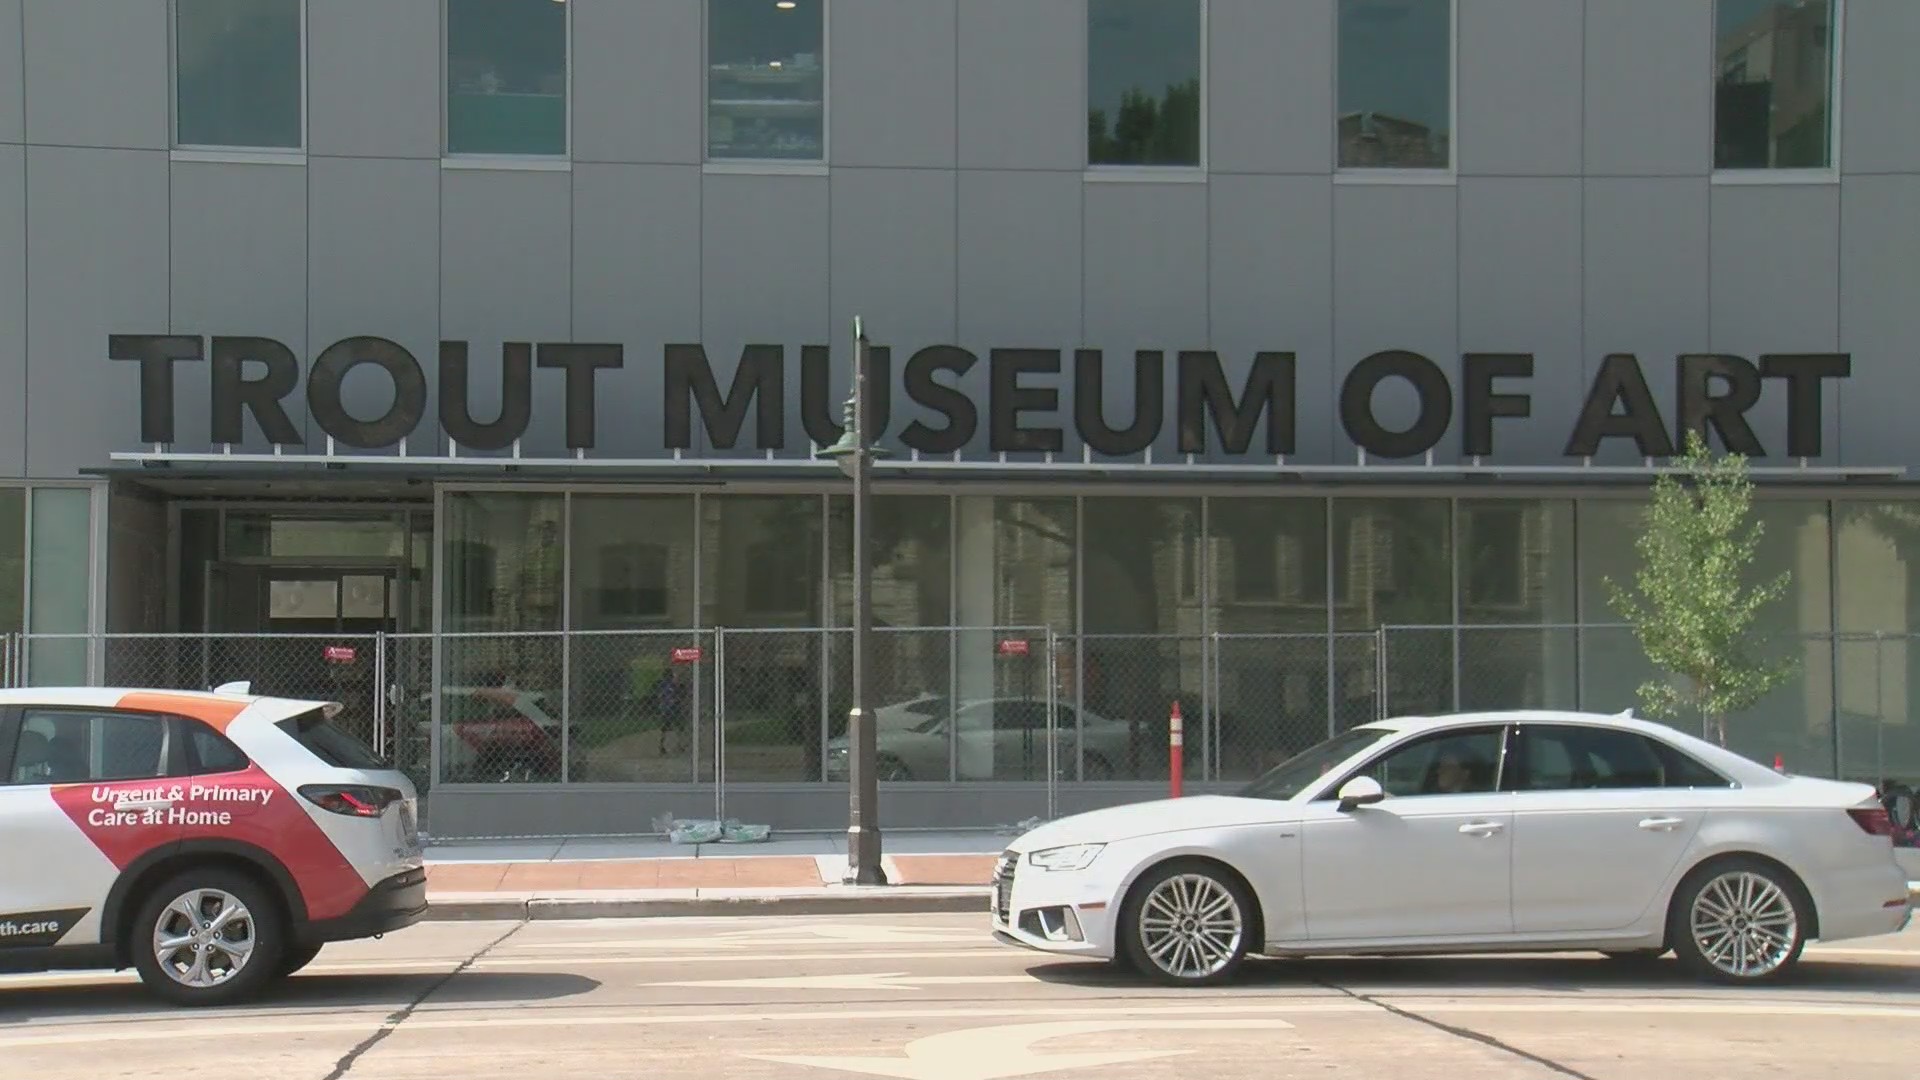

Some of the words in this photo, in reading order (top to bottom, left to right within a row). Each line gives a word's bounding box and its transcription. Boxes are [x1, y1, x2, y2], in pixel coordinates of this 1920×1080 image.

[109, 334, 624, 449] TROUT
[664, 344, 1296, 456] MUSEUM
[1340, 350, 1534, 458] OF
[1563, 353, 1851, 457] ART
[91, 786, 164, 806] Urgent
[167, 785, 184, 801] &
[190, 784, 274, 805] Primary
[88, 808, 138, 827] Care
[142, 809, 164, 825] at
[168, 807, 231, 825] Home
